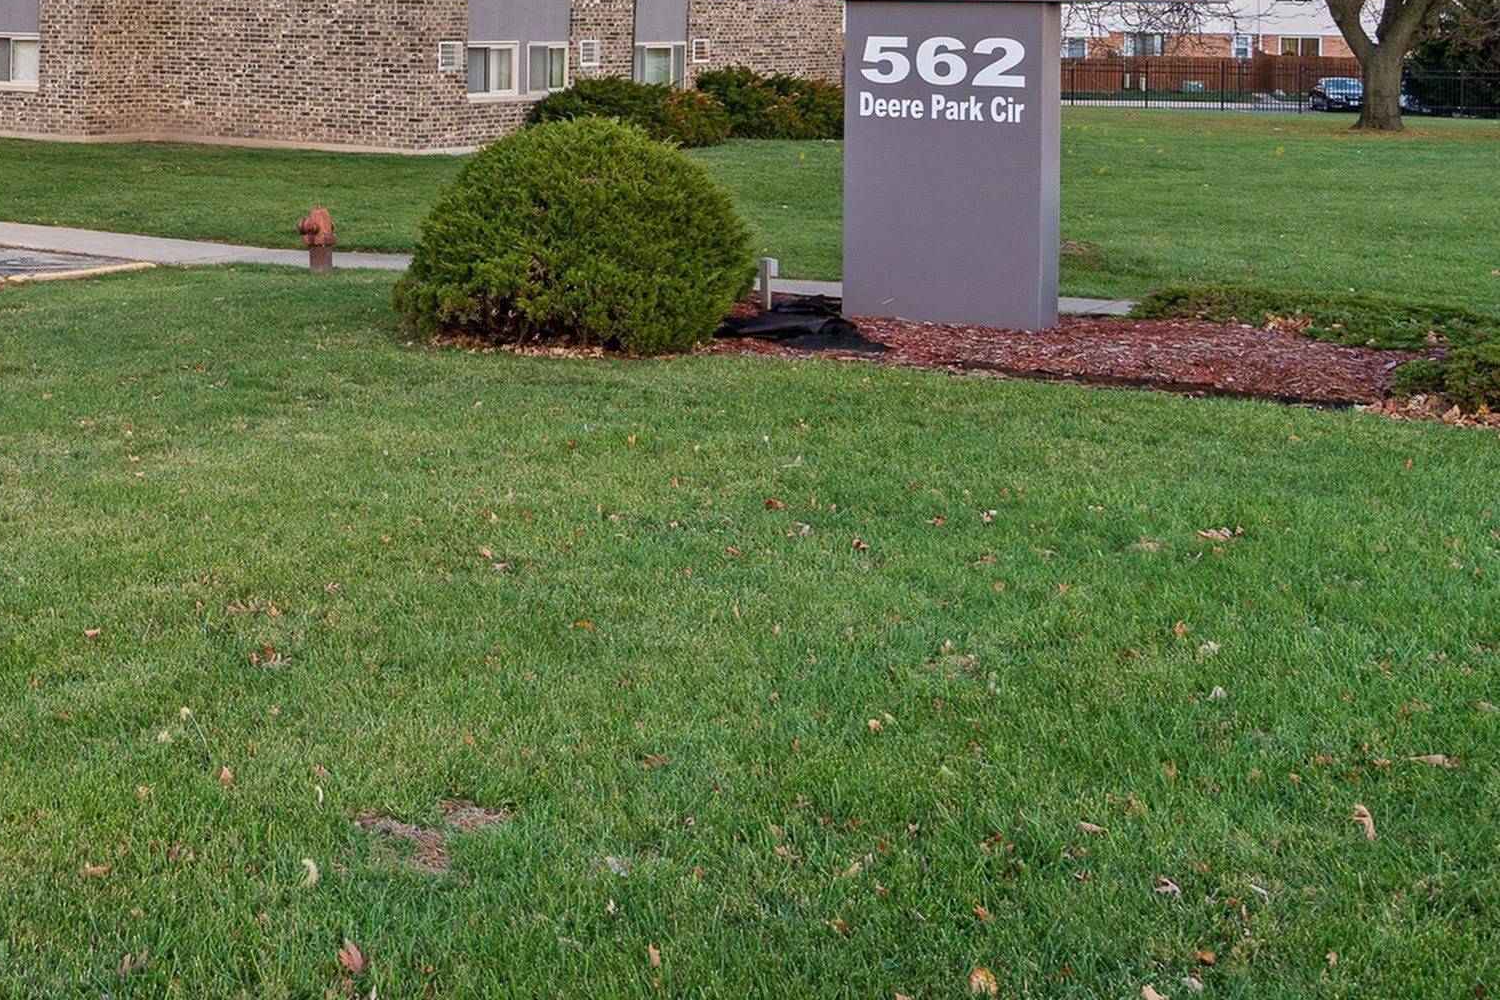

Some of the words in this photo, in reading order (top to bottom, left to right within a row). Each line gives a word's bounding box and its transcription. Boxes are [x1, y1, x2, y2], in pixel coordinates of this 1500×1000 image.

[860, 35, 1026, 88] 562
[859, 91, 924, 119] Deere
[931, 94, 984, 122] Park
[990, 96, 1026, 124] Cir
